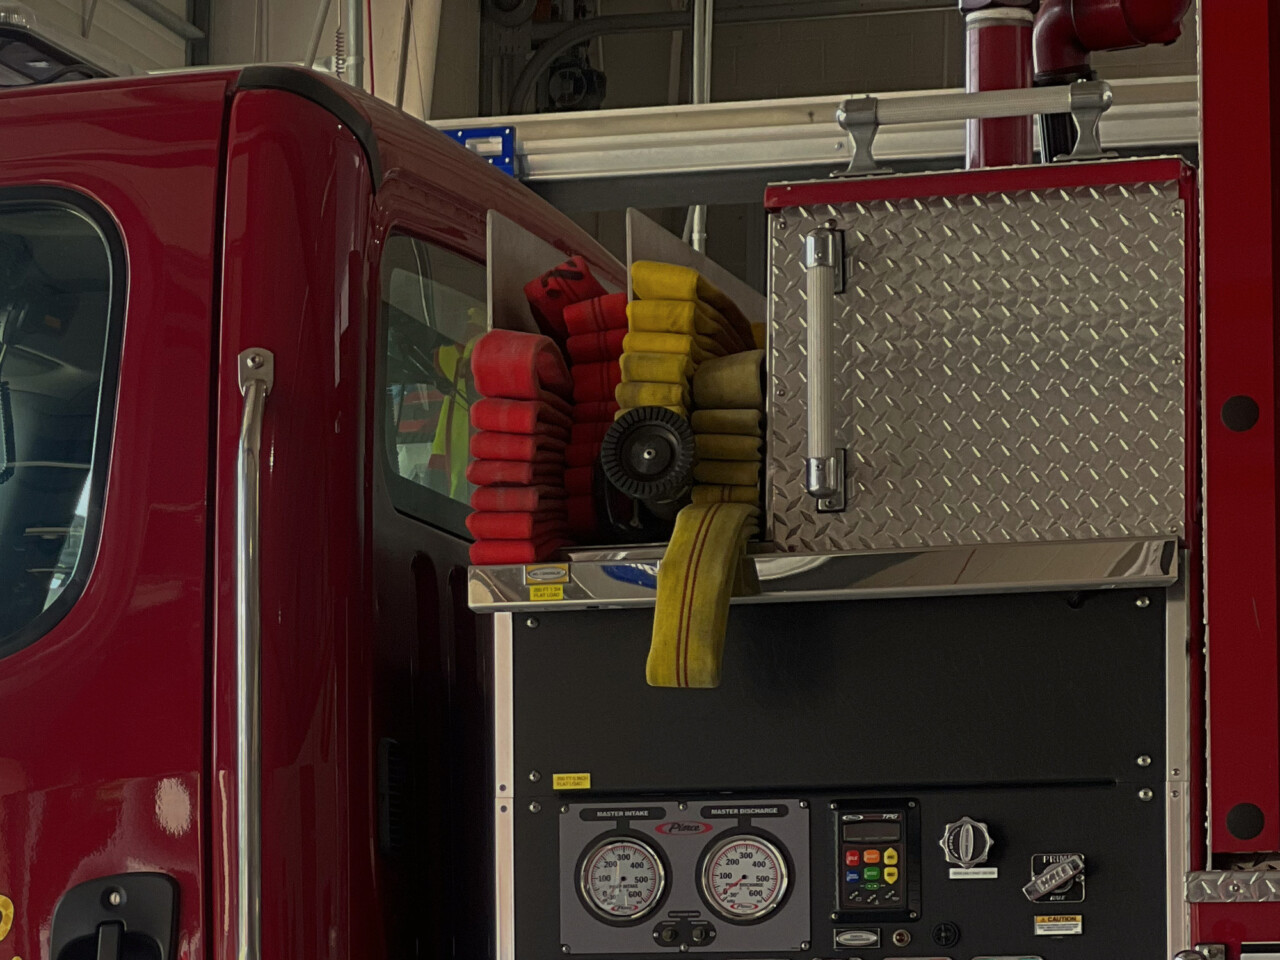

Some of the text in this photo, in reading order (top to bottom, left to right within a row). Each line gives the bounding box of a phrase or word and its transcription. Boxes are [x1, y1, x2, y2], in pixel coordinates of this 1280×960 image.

[596, 809, 649, 818] MASTER INTAKE
[739, 807, 778, 815] DISCHARGE
[668, 822, 701, 833] Pierce
[616, 853, 631, 861] 300
[604, 860, 618, 868] 200
[630, 861, 644, 869] 400
[725, 858, 740, 866] 200
[752, 860, 766, 868] 400
[598, 874, 611, 883] 100
[634, 876, 649, 884] 500
[719, 872, 733, 880] 100
[755, 875, 770, 883] 500
[628, 890, 643, 898] 600
[748, 889, 763, 897] 600
